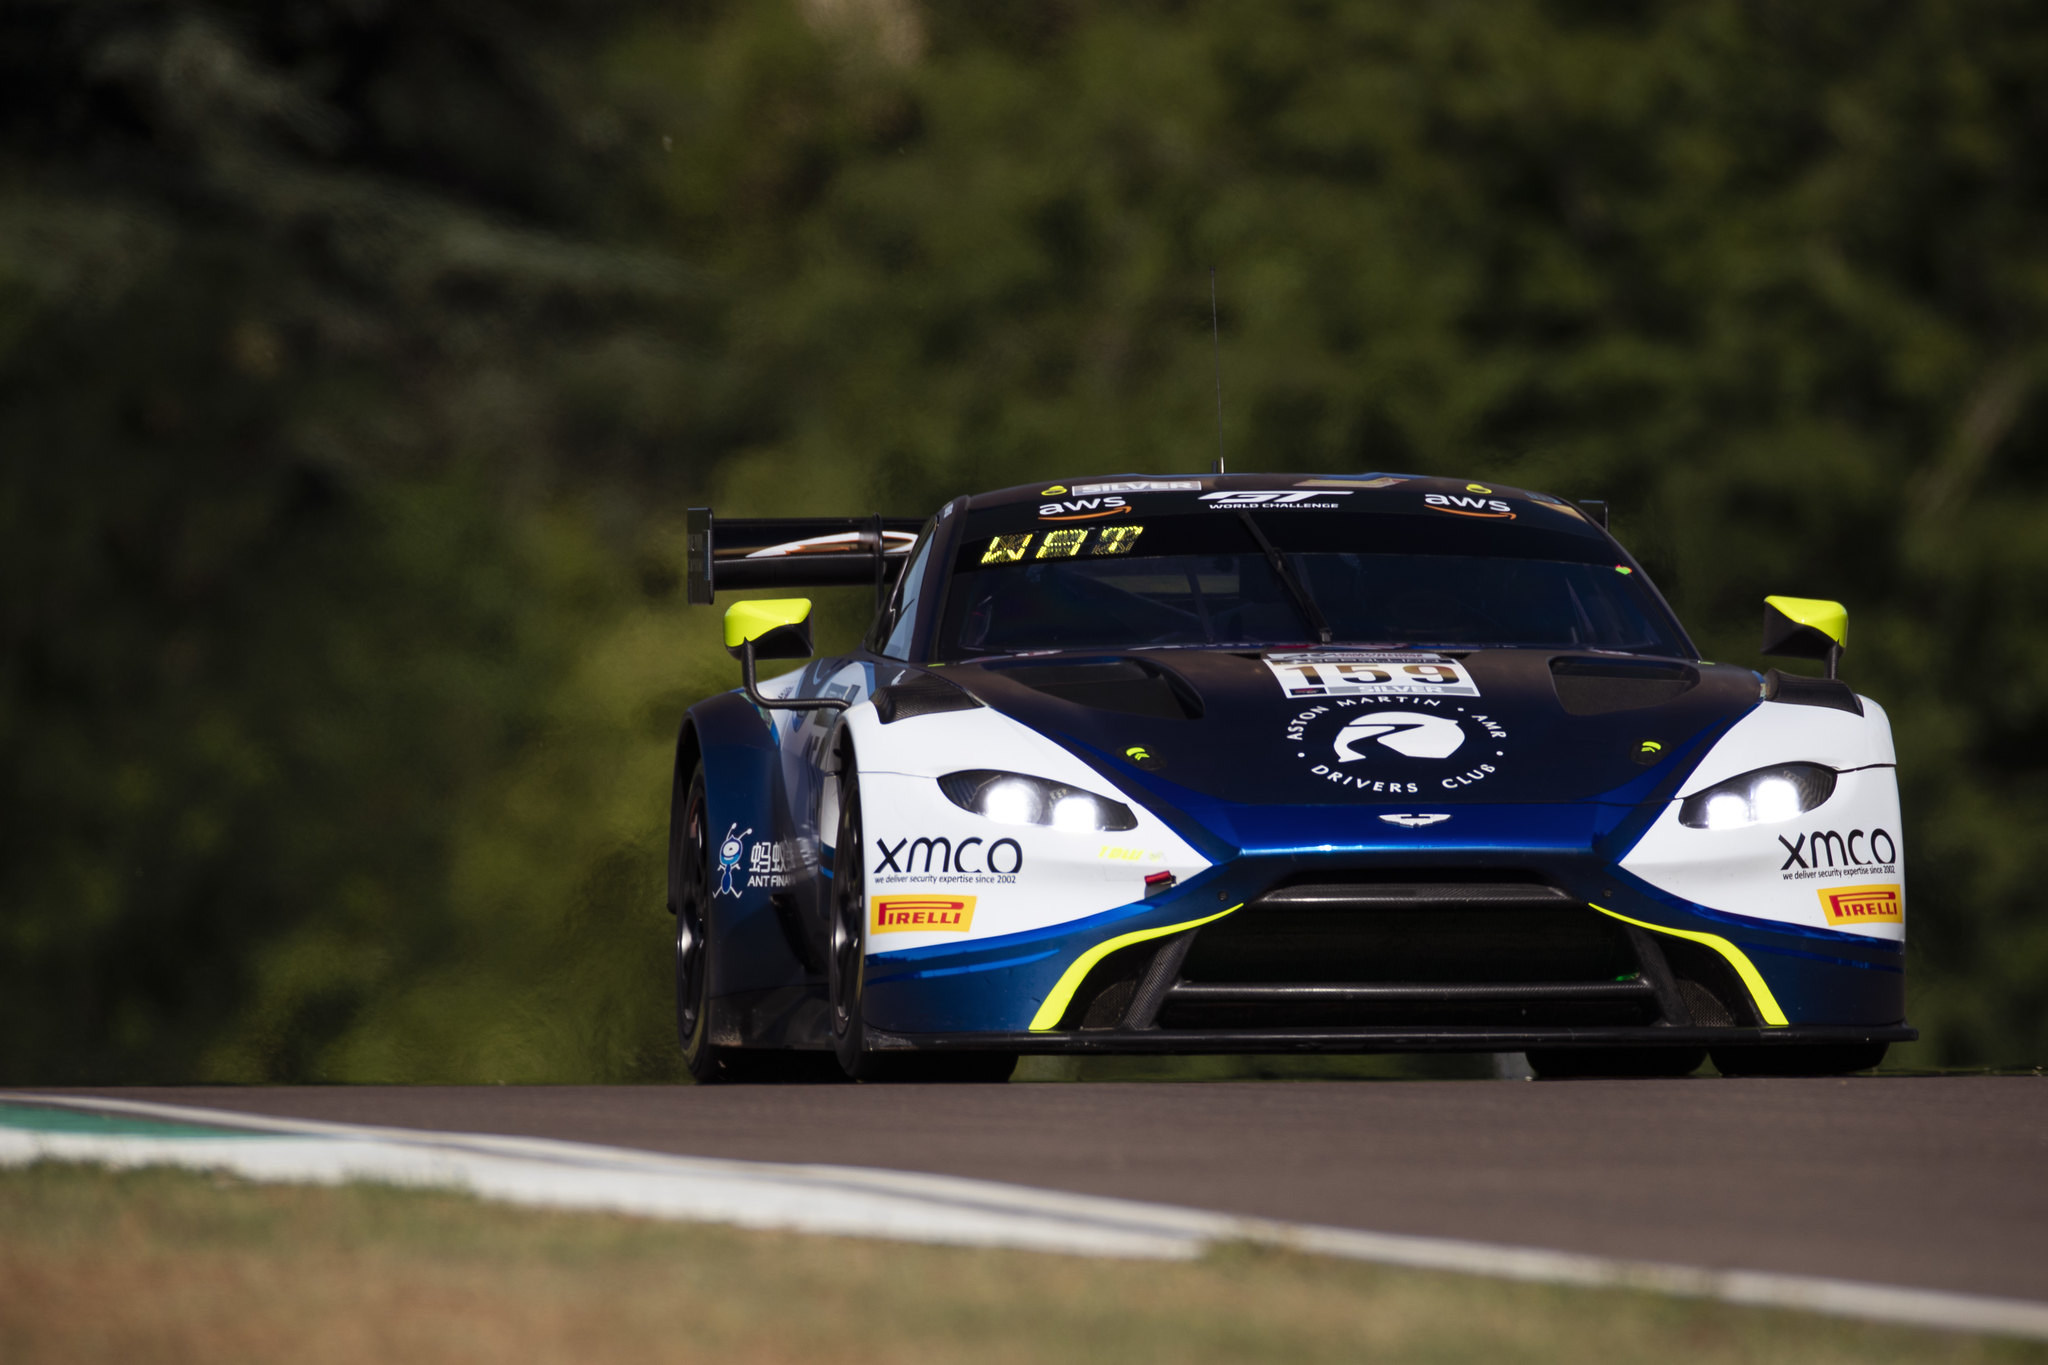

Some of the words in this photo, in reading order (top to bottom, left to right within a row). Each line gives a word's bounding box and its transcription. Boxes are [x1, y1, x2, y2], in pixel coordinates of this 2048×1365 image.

[1080, 482, 1192, 493] SILVER
[1198, 491, 1354, 503] GT
[1039, 496, 1126, 515] aws
[1424, 493, 1511, 512] aws
[1285, 664, 1460, 685] 159
[1287, 706, 1329, 740] ASTON
[1337, 696, 1441, 707] MARTIN
[1471, 714, 1507, 738] AMR
[1311, 765, 1418, 793] DRIVERS
[1442, 764, 1496, 789] CLUB
[873, 836, 1023, 874] xmco
[1778, 828, 1896, 871] xmco
[747, 875, 770, 887] ANT
[875, 876, 884, 884] we
[885, 874, 908, 884] deliver
[910, 874, 937, 884] security
[939, 874, 974, 885] expertise
[975, 874, 995, 884] since
[997, 875, 1016, 884] 2002
[1795, 871, 1816, 880] deliver
[1818, 868, 1842, 878] security
[1843, 866, 1869, 876] expertise
[1870, 866, 1883, 874] since
[1884, 865, 1895, 874] 2002
[878, 901, 964, 926] PIRELLI
[1829, 891, 1898, 917] PIRELLI
